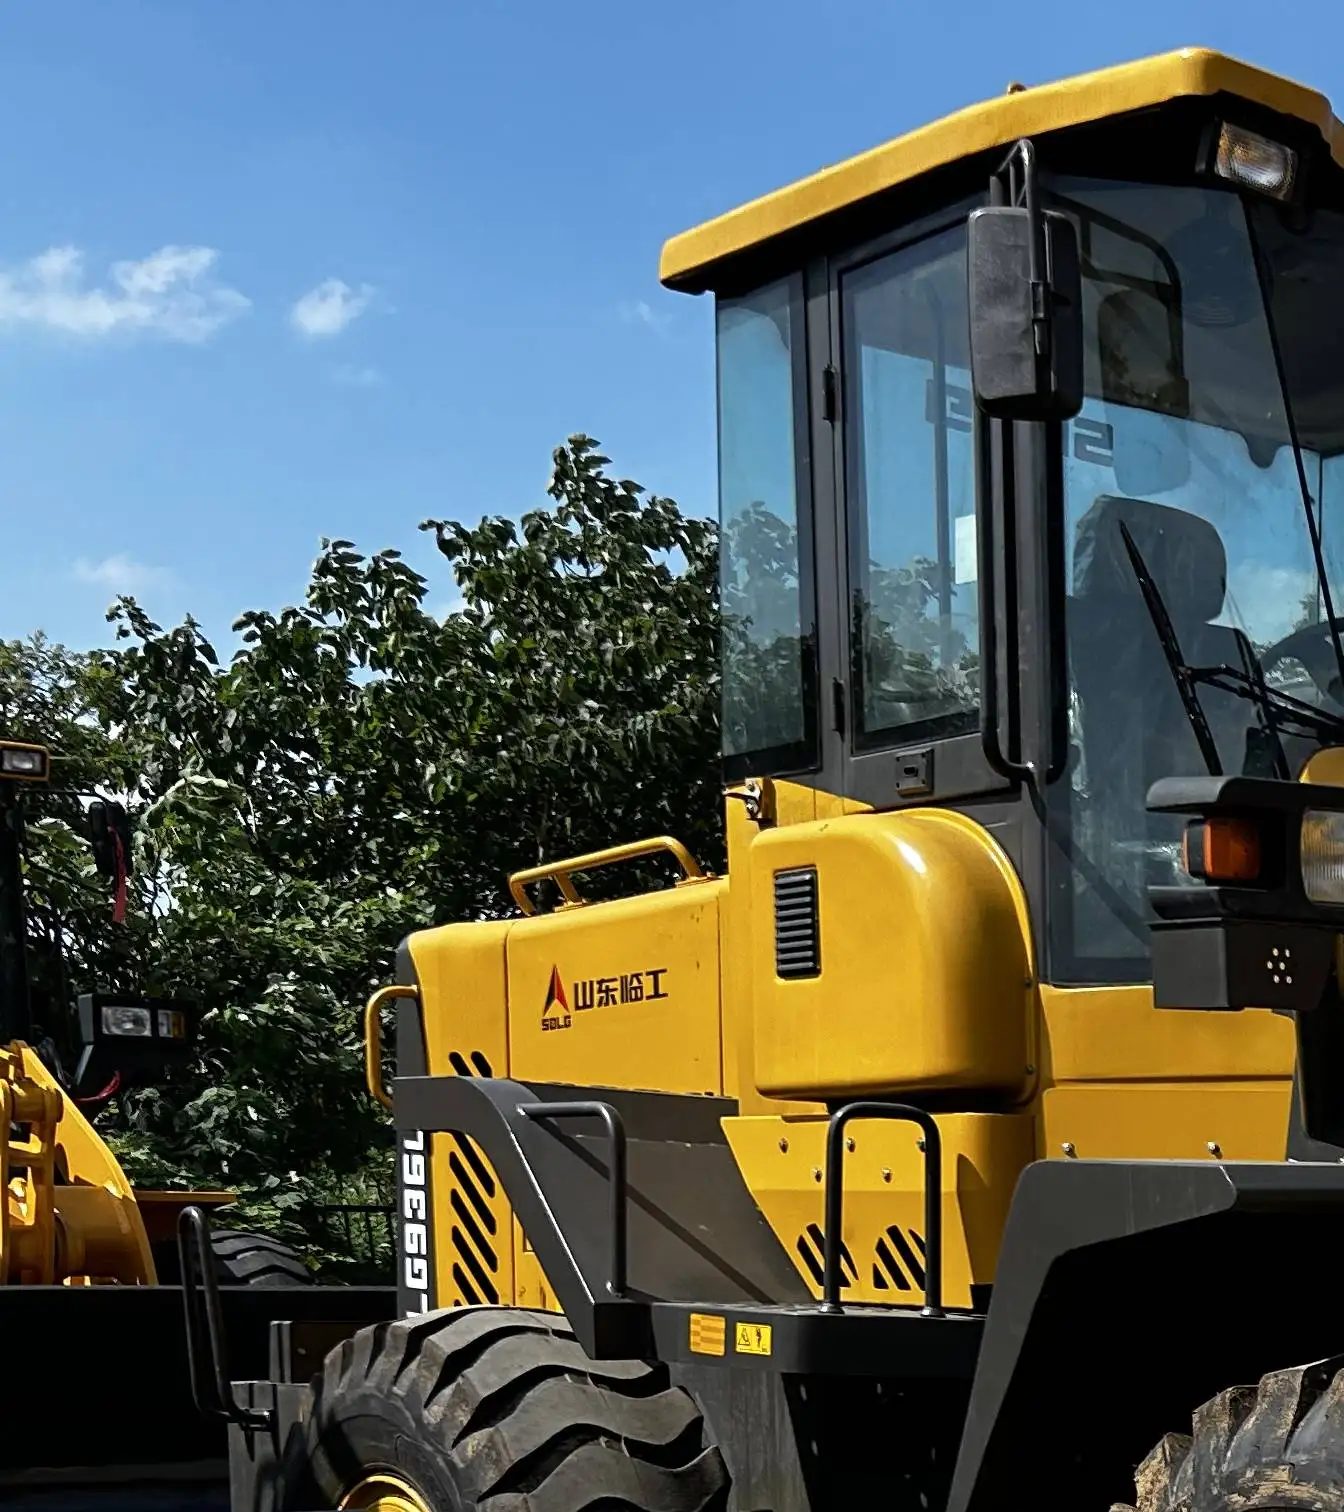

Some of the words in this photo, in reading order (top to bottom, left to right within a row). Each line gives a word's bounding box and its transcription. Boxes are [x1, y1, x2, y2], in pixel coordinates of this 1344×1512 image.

[574, 968, 669, 1012] 山东临工
[541, 1015, 571, 1032] SDLG
